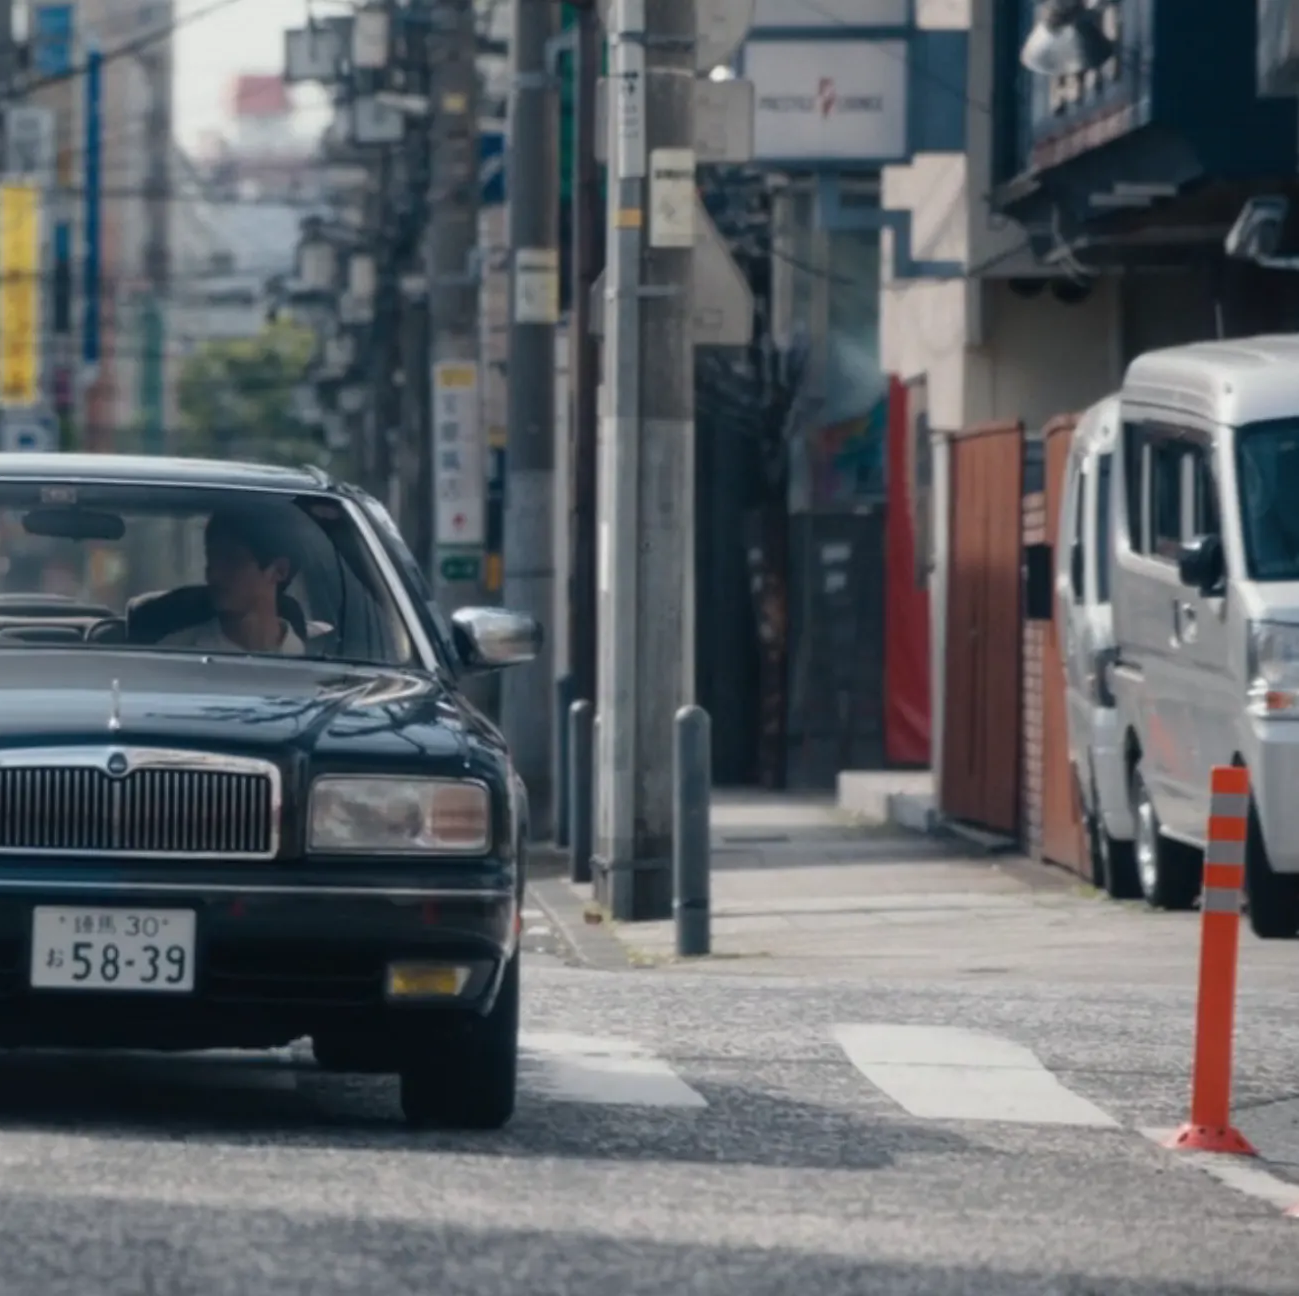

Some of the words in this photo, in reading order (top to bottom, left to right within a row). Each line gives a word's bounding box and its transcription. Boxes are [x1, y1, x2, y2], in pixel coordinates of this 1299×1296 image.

[124, 915, 159, 937] 30
[46, 947, 64, 968] お
[72, 942, 185, 984] 58-39
